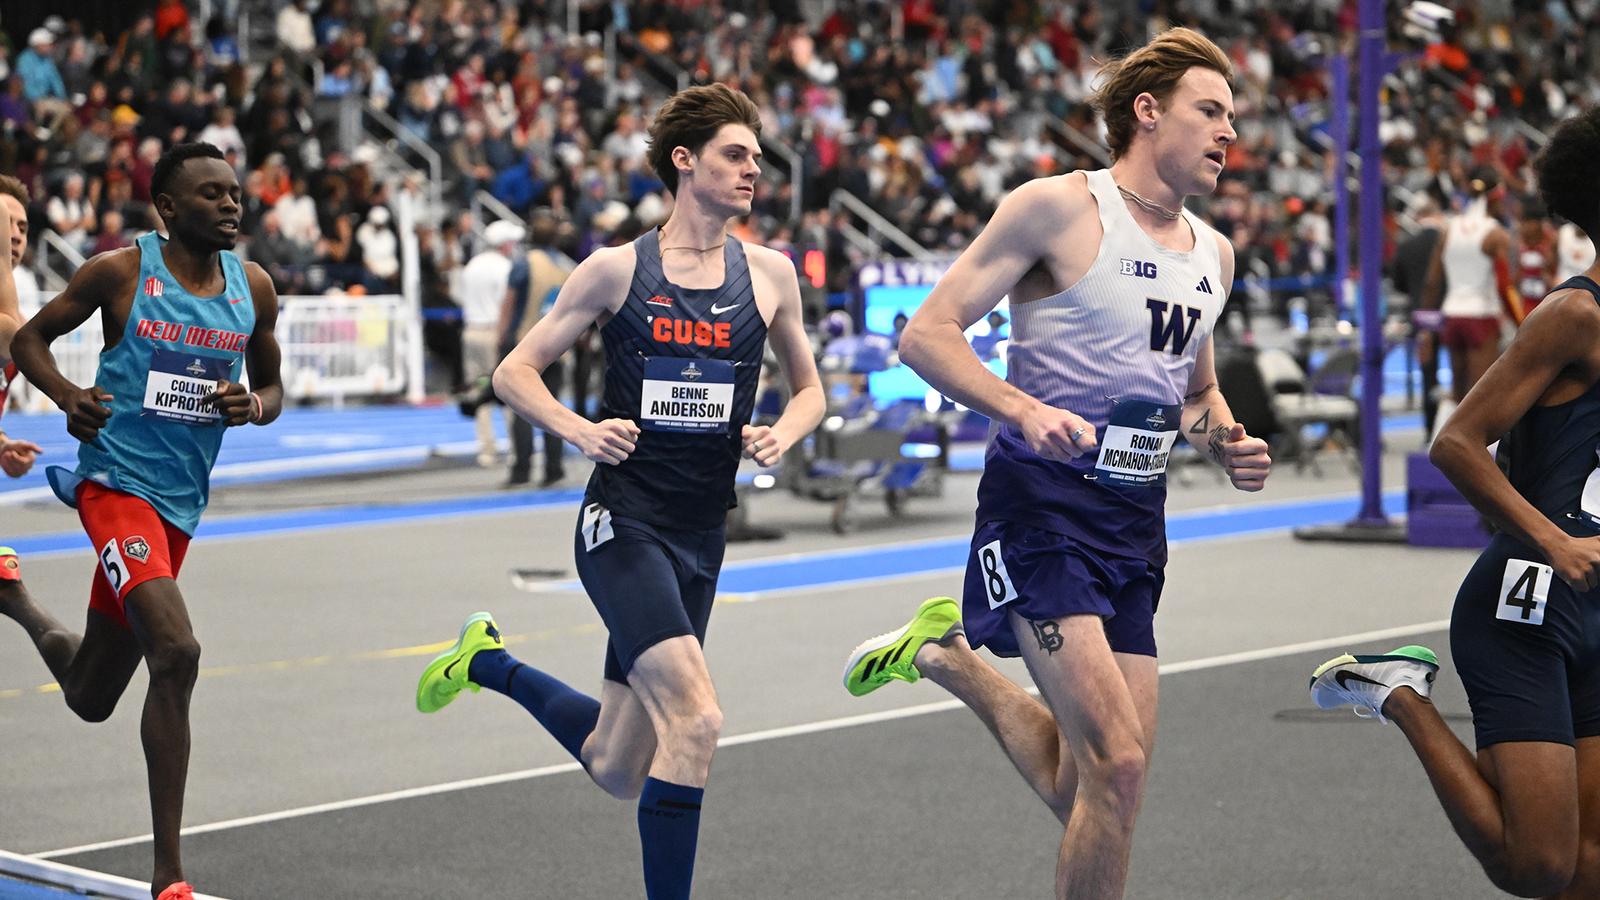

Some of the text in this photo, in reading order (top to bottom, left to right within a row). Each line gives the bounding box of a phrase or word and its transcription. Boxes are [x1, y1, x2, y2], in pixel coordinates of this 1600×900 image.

[136, 319, 184, 343] NEW
[1146, 298, 1201, 356] W
[171, 379, 213, 397] COLLINS
[671, 386, 709, 400] BENNE
[650, 400, 724, 418] ANDERSON
[1130, 434, 1164, 452] RONA
[102, 546, 122, 590] 5
[983, 548, 1007, 603] 8
[1505, 565, 1539, 620] 4
